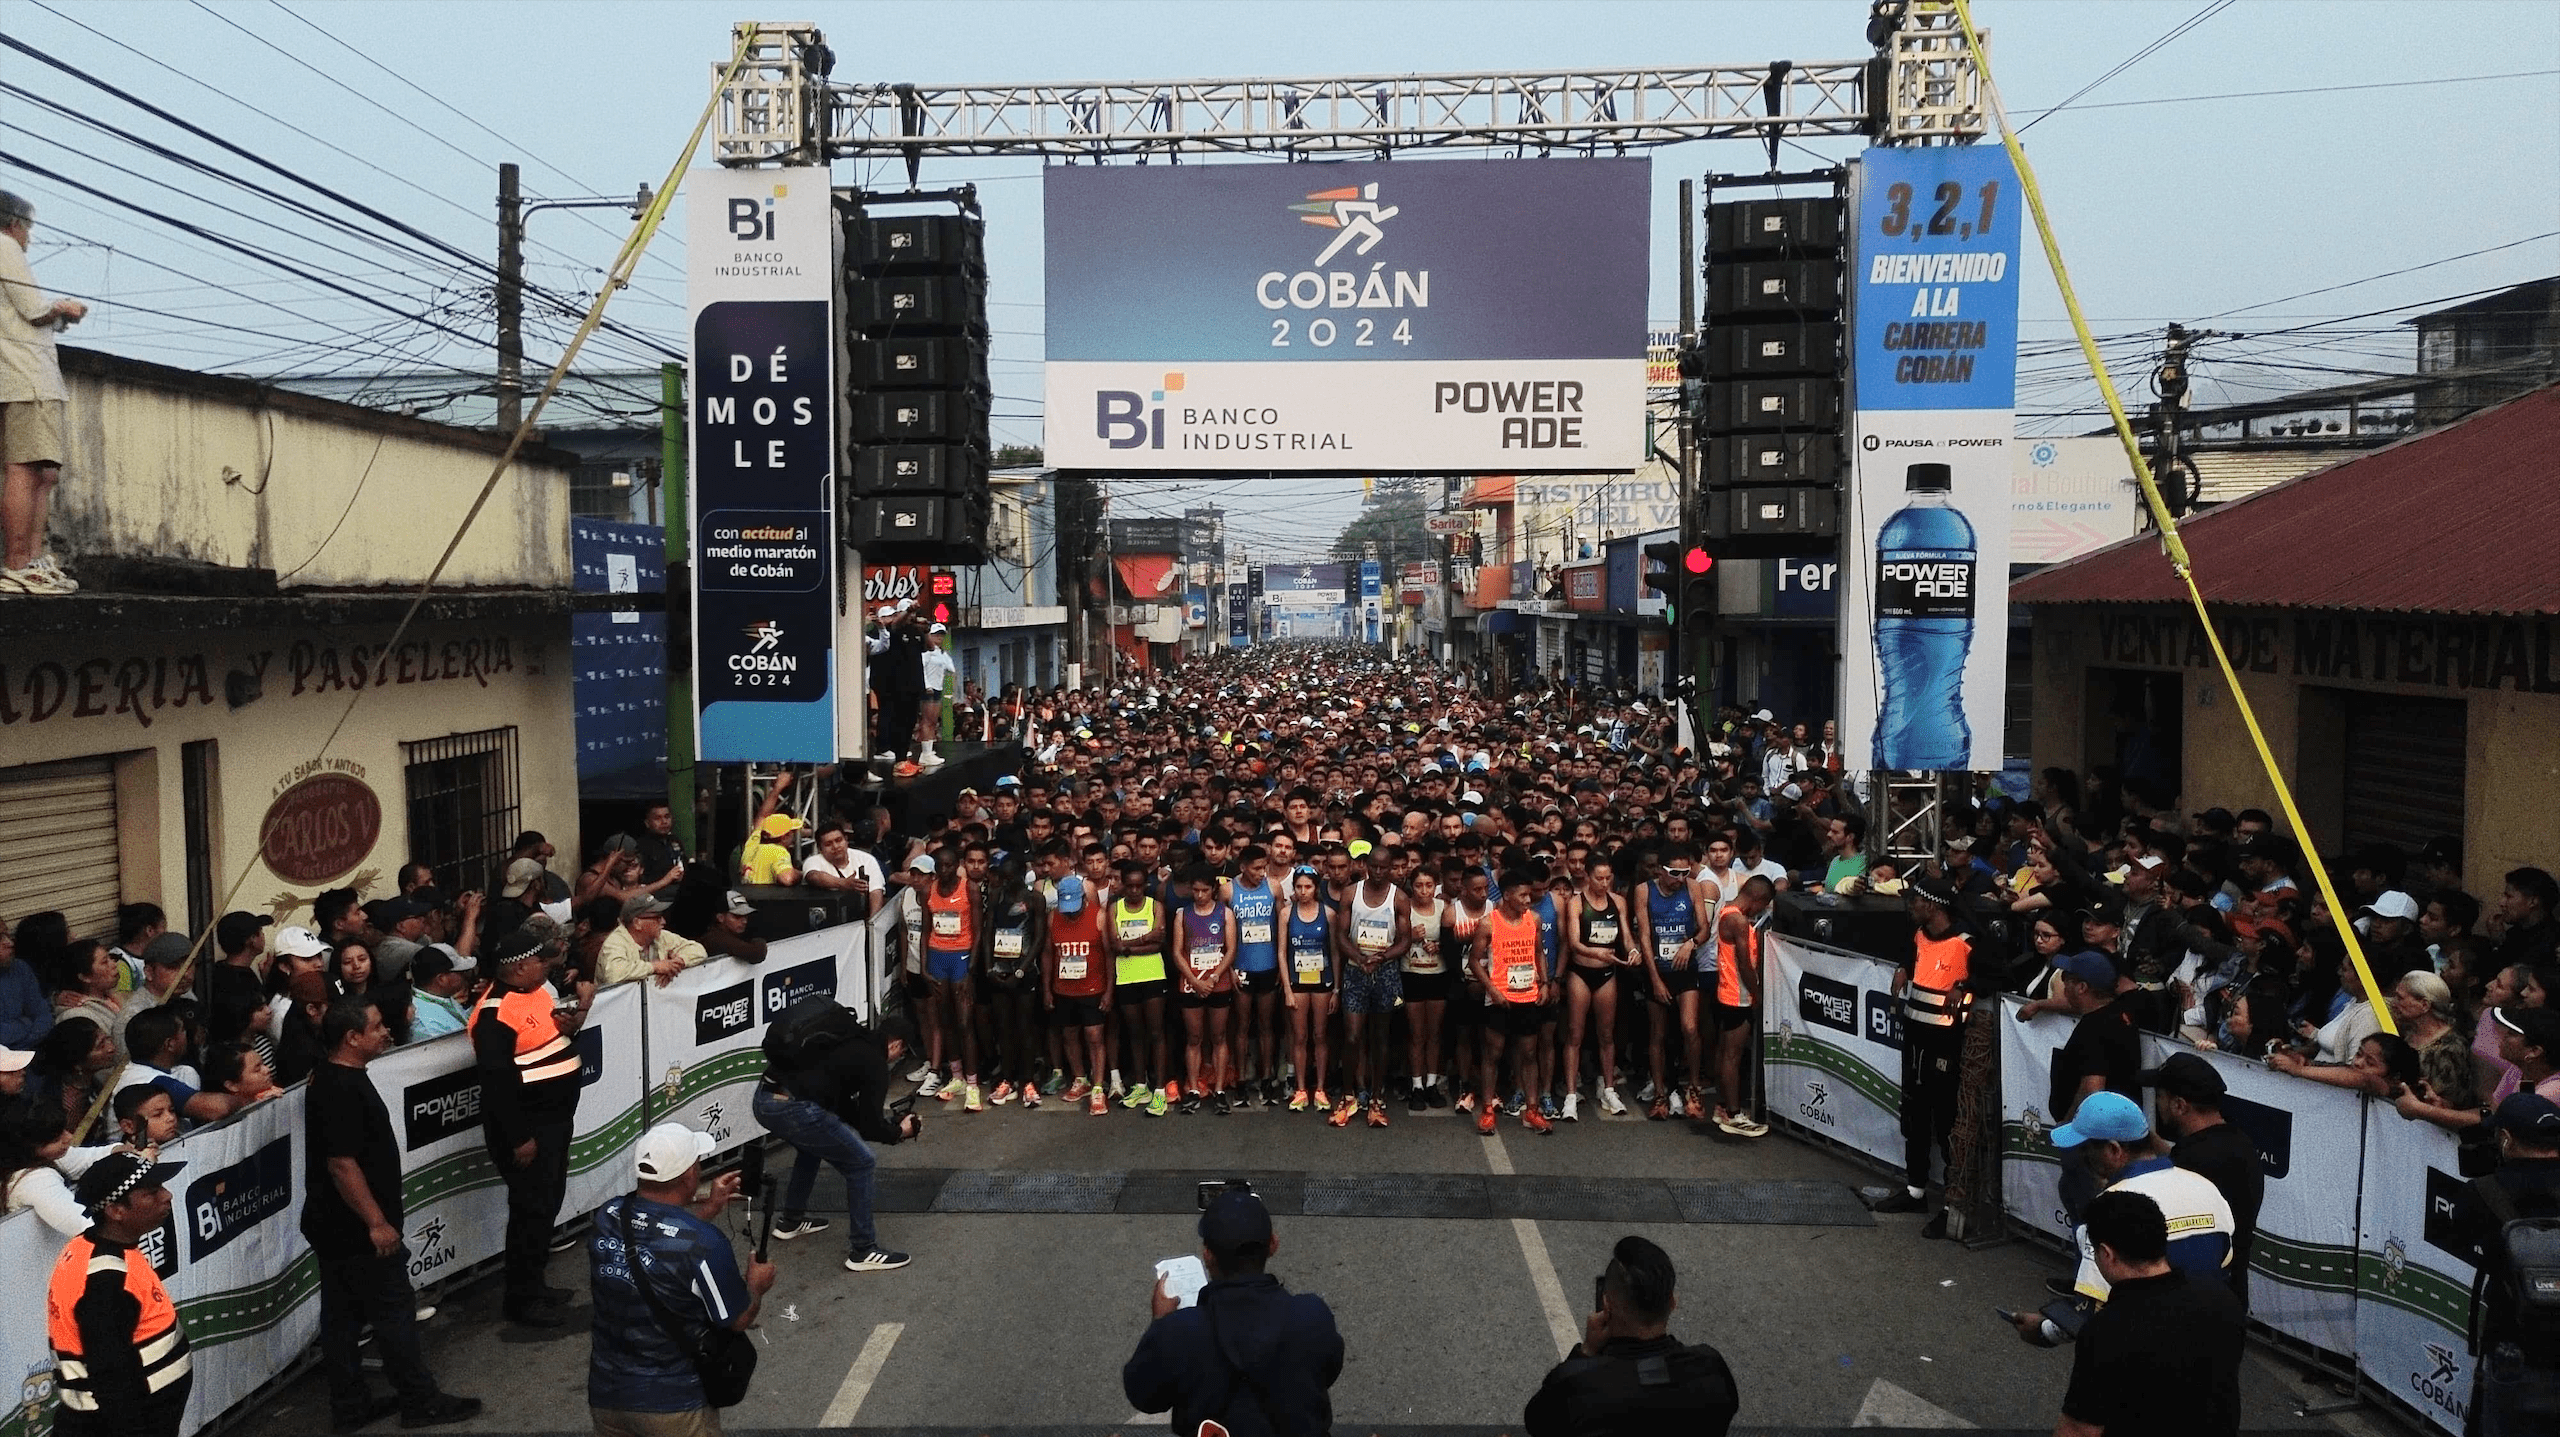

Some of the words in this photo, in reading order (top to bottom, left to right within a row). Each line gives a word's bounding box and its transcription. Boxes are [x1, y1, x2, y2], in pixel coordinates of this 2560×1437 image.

[728, 197, 775, 241] Bi
[1881, 180, 1999, 242] 3,2,1
[715, 266, 802, 276] INDUSTRIAL
[734, 253, 784, 263] BANCO
[1870, 253, 2007, 284] BIENVENIDO
[1256, 261, 1429, 309] COBÁN
[1911, 288, 1929, 318] A
[1930, 287, 1959, 317] LA
[1271, 318, 1413, 347] 2024
[1883, 320, 1987, 351] CARRERA
[730, 345, 788, 383] DÉ
[1895, 352, 1975, 384] COBÁN
[1435, 380, 1583, 413] POWER
[707, 396, 813, 426] MOS
[1096, 390, 1165, 450] Bi
[1183, 408, 1279, 425] BANCO
[1183, 433, 1353, 450] INDUSTRIAL
[1503, 417, 1582, 449] ADE
[1886, 439, 1934, 448] PAUSA
[1948, 438, 2003, 448] POWER
[734, 439, 786, 469] LE
[1430, 518, 1463, 530] Sarita
[1577, 505, 1641, 525] DEL
[714, 529, 739, 540] con
[741, 525, 795, 541] actitud
[796, 527, 808, 540] al
[707, 545, 751, 559] medio
[754, 544, 816, 560] maratón
[730, 563, 748, 577] de
[750, 562, 794, 578] Cobán
[1882, 563, 1969, 581] POWER
[1914, 581, 1969, 598] ADE
[728, 652, 797, 671] COBÁN
[734, 674, 791, 686] 2024
[1655, 924, 1687, 934] BLUE
[790, 983, 814, 997] BANCO
[1804, 988, 1852, 1014] POWER
[702, 997, 749, 1022] POWER
[722, 1009, 748, 1029] ADE
[1823, 1007, 1851, 1025] ADE
[413, 1085, 482, 1121] POWER
[441, 1100, 481, 1126] ADE
[1800, 1101, 1835, 1128] COBÁN
[222, 1185, 261, 1213] BANCO
[224, 1188, 286, 1226] INDUSTRIAL
[411, 1245, 456, 1277] OBÁN
